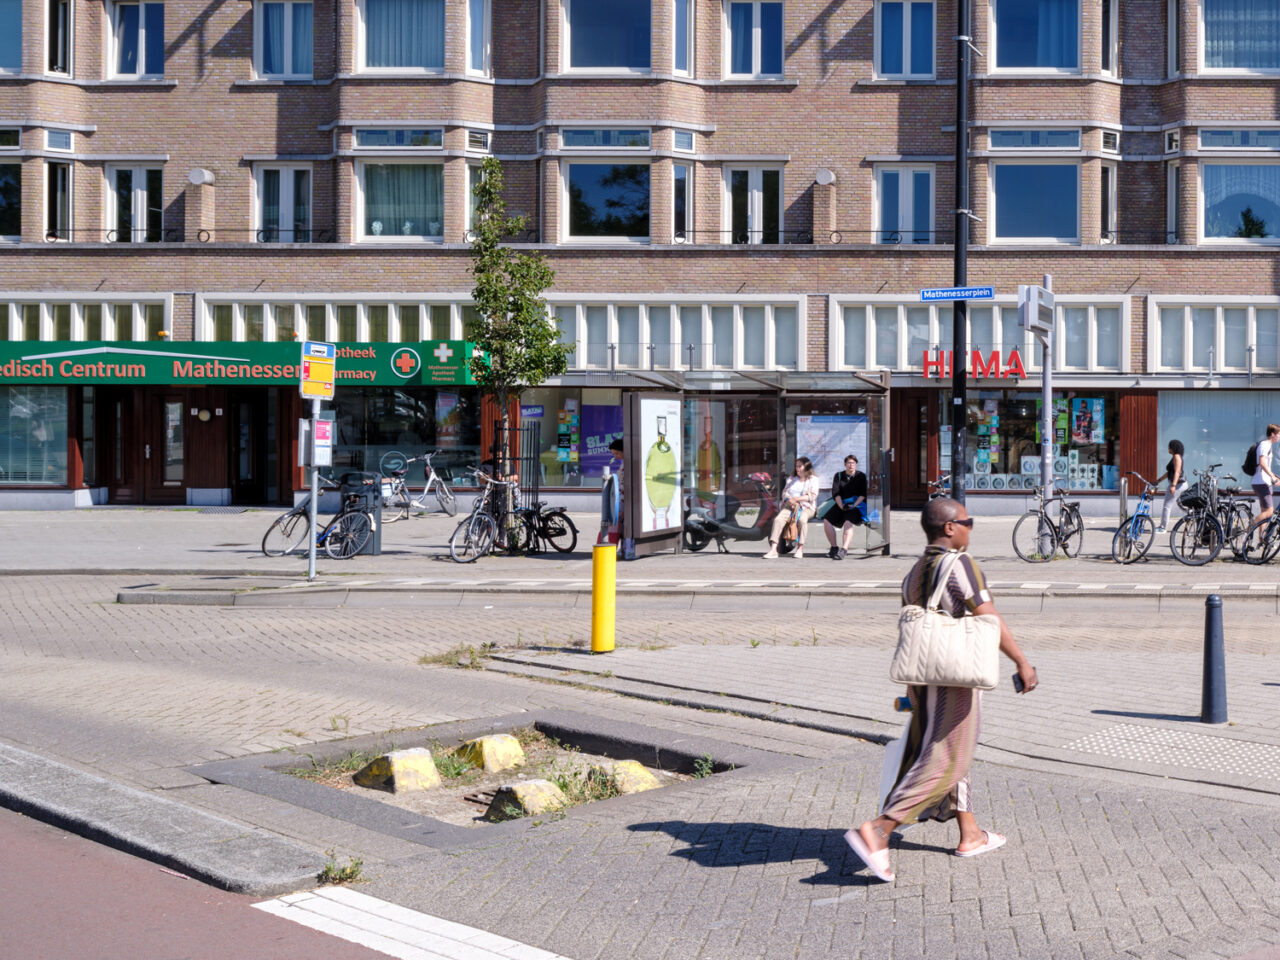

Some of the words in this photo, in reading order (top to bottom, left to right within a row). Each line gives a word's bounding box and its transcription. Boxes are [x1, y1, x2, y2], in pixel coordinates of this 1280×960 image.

[923, 288, 991, 299] Mathenesserplein
[335, 346, 376, 359] otheek
[0, 359, 54, 378] disch
[59, 360, 146, 378] Centrum
[173, 360, 301, 378] Mathenesser
[923, 350, 1027, 378] HMA
[335, 369, 377, 381] armacy
